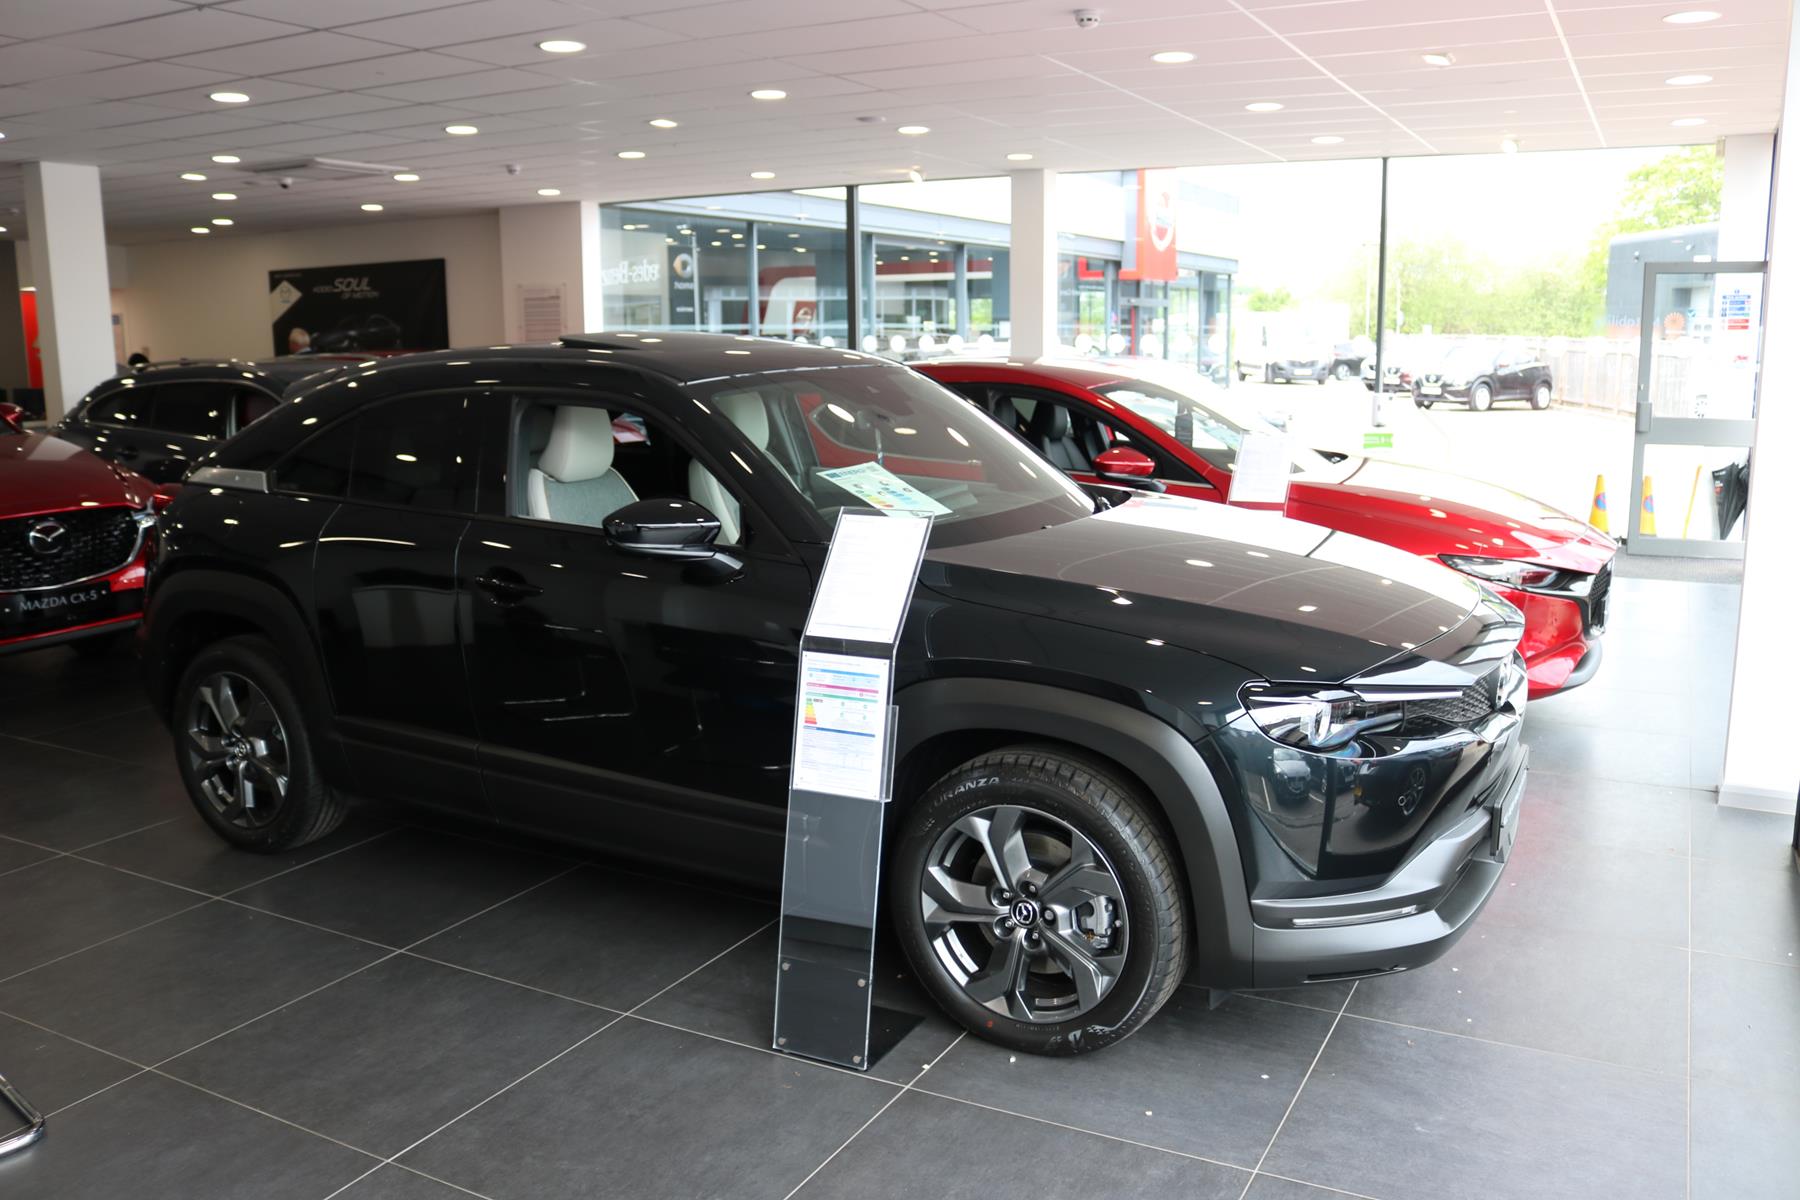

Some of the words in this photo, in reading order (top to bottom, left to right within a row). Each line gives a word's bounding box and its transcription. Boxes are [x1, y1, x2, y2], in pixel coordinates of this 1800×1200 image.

[333, 277, 371, 293] SOUL
[20, 596, 68, 611] MAZDA
[70, 590, 97, 604] CX-5
